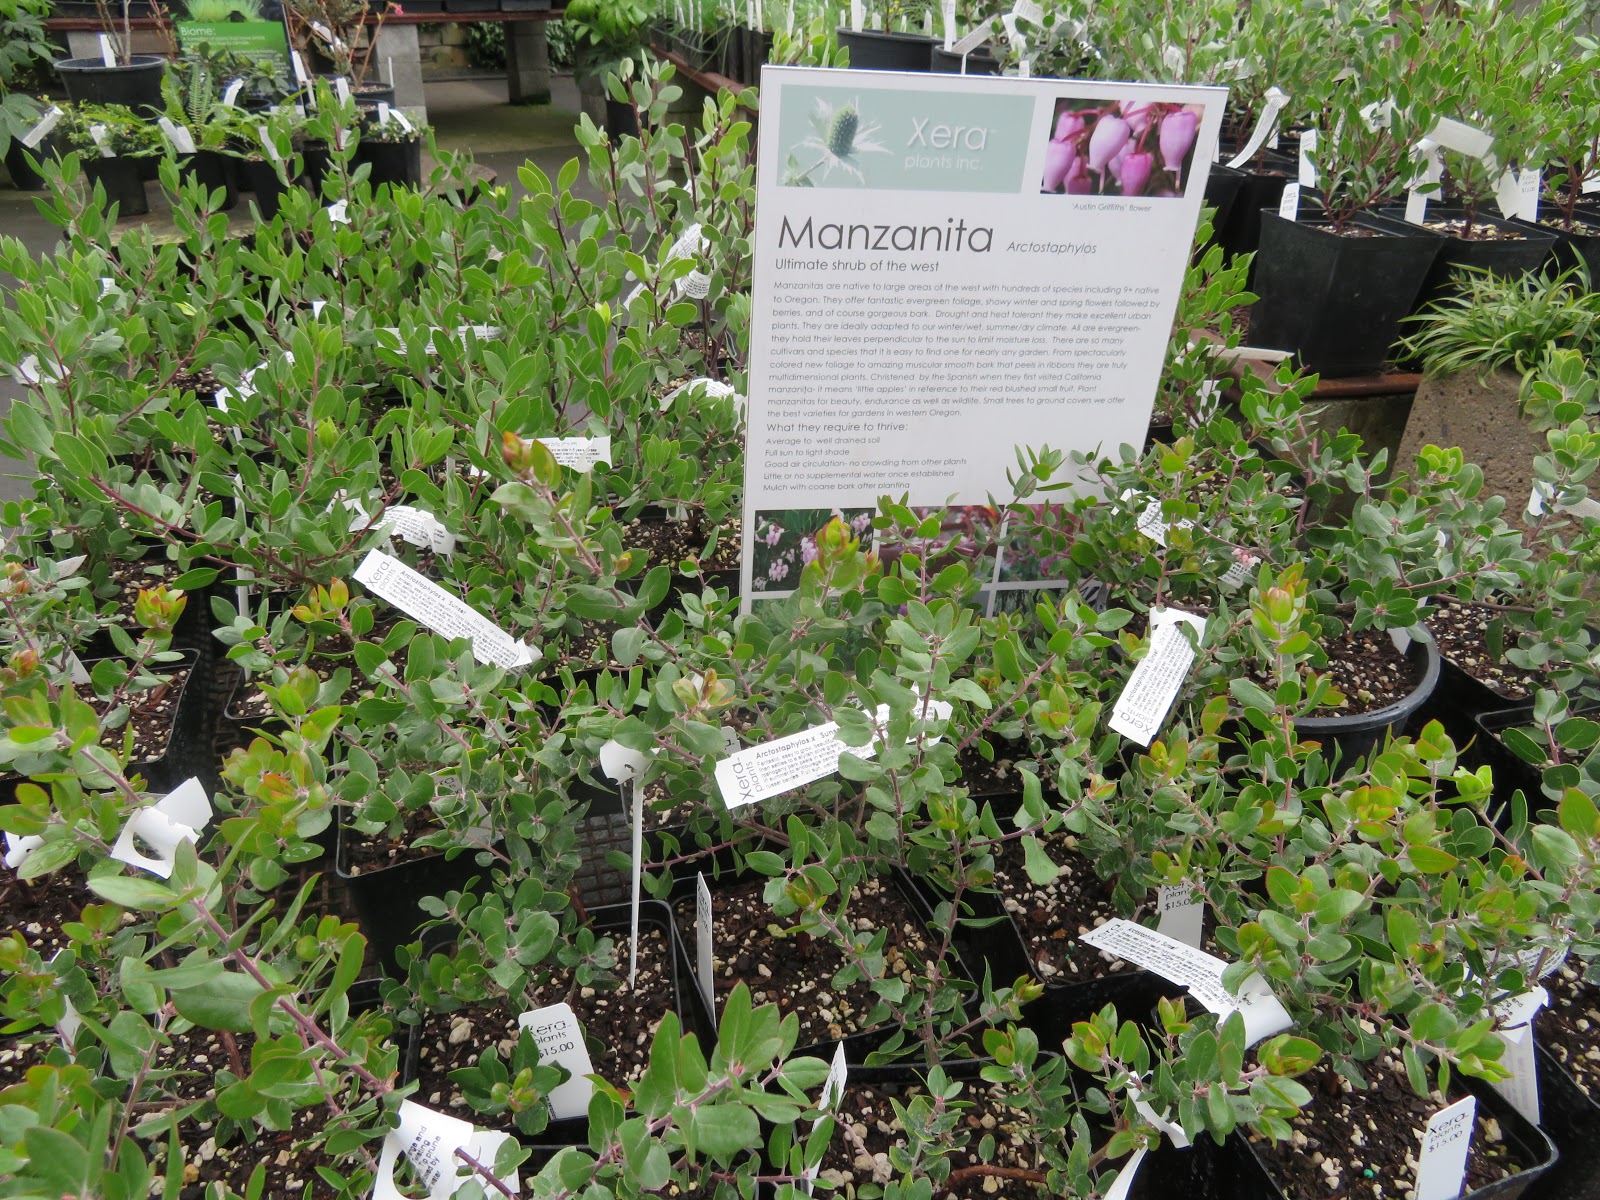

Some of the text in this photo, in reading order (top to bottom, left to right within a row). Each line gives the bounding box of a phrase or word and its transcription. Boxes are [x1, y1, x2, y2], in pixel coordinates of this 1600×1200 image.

[180, 26, 217, 36] Biome:
[906, 116, 988, 151] Xera
[904, 154, 984, 171] plants inc.
[777, 214, 1097, 256] Manzanita Arctostaphylos
[775, 257, 939, 272] Ultimate shrub of the west
[773, 280, 823, 289] Manzanitas
[842, 281, 870, 290] native
[872, 282, 881, 290] to
[883, 282, 905, 292] large
[907, 283, 931, 291] areas
[933, 282, 943, 291] of
[944, 283, 958, 291] the
[960, 283, 980, 291] west
[982, 283, 999, 291] with
[1001, 284, 1040, 292] hundreds
[1041, 284, 1051, 292] of
[1052, 284, 1083, 294] species
[1084, 285, 1121, 295] including
[1134, 286, 1159, 294] native
[773, 295, 782, 303] to
[784, 295, 820, 305] Oregon.
[822, 295, 843, 305] They
[844, 295, 865, 304] offer
[867, 295, 904, 304] fantastic
[906, 298, 950, 306] evergreen
[952, 296, 983, 307] foliage,
[985, 297, 1011, 306] showy
[1039, 298, 1057, 306] and
[1058, 298, 1083, 308] spring
[1084, 298, 1112, 307] flowers
[1114, 298, 1148, 307] followed
[1149, 300, 1160, 308] by
[772, 308, 802, 316] berries,
[805, 308, 823, 316] and
[825, 308, 834, 316] of
[866, 310, 907, 319] gorgeous
[909, 309, 930, 317] bark.
[935, 309, 969, 319] Drought
[970, 310, 988, 318] and
[989, 310, 1009, 318] heat
[1011, 310, 1043, 318] tolerant
[1045, 311, 1063, 320] they
[1064, 311, 1088, 319] make
[1089, 311, 1126, 319] excellent
[771, 321, 799, 330] plants.
[802, 321, 822, 330] They
[840, 321, 868, 330] ideally
[870, 322, 909, 331] adapted
[911, 322, 920, 330] to
[985, 323, 1034, 332] summer/dry
[1036, 323, 1068, 331] climate.
[1070, 323, 1081, 331] All
[782, 409, 800, 417] best
[802, 409, 836, 417] varieties
[850, 409, 884, 418] gardens
[886, 408, 893, 416] in
[928, 408, 961, 417] Oregon.
[766, 421, 908, 433] What they require to thrive:
[765, 437, 801, 446] Average
[815, 436, 832, 444] well
[834, 436, 866, 444] drained
[805, 448, 822, 457] light
[764, 460, 788, 468] Good
[861, 458, 899, 467] crowding
[943, 457, 966, 465] plants
[806, 471, 861, 479] supplemental
[910, 469, 954, 477] established
[365, 558, 390, 588] Xera
[1119, 710, 1153, 735] Xera
[754, 737, 810, 760] Arctostaphylos
[731, 761, 754, 801] Xera
[744, 760, 764, 793] plants
[1165, 889, 1190, 901] plan
[1164, 897, 1192, 911] $15.0
[539, 1041, 575, 1059] $15.00
[1428, 1113, 1466, 1136] Xera
[1430, 1123, 1461, 1143] plants
[1429, 1130, 1463, 1153] $15.00
